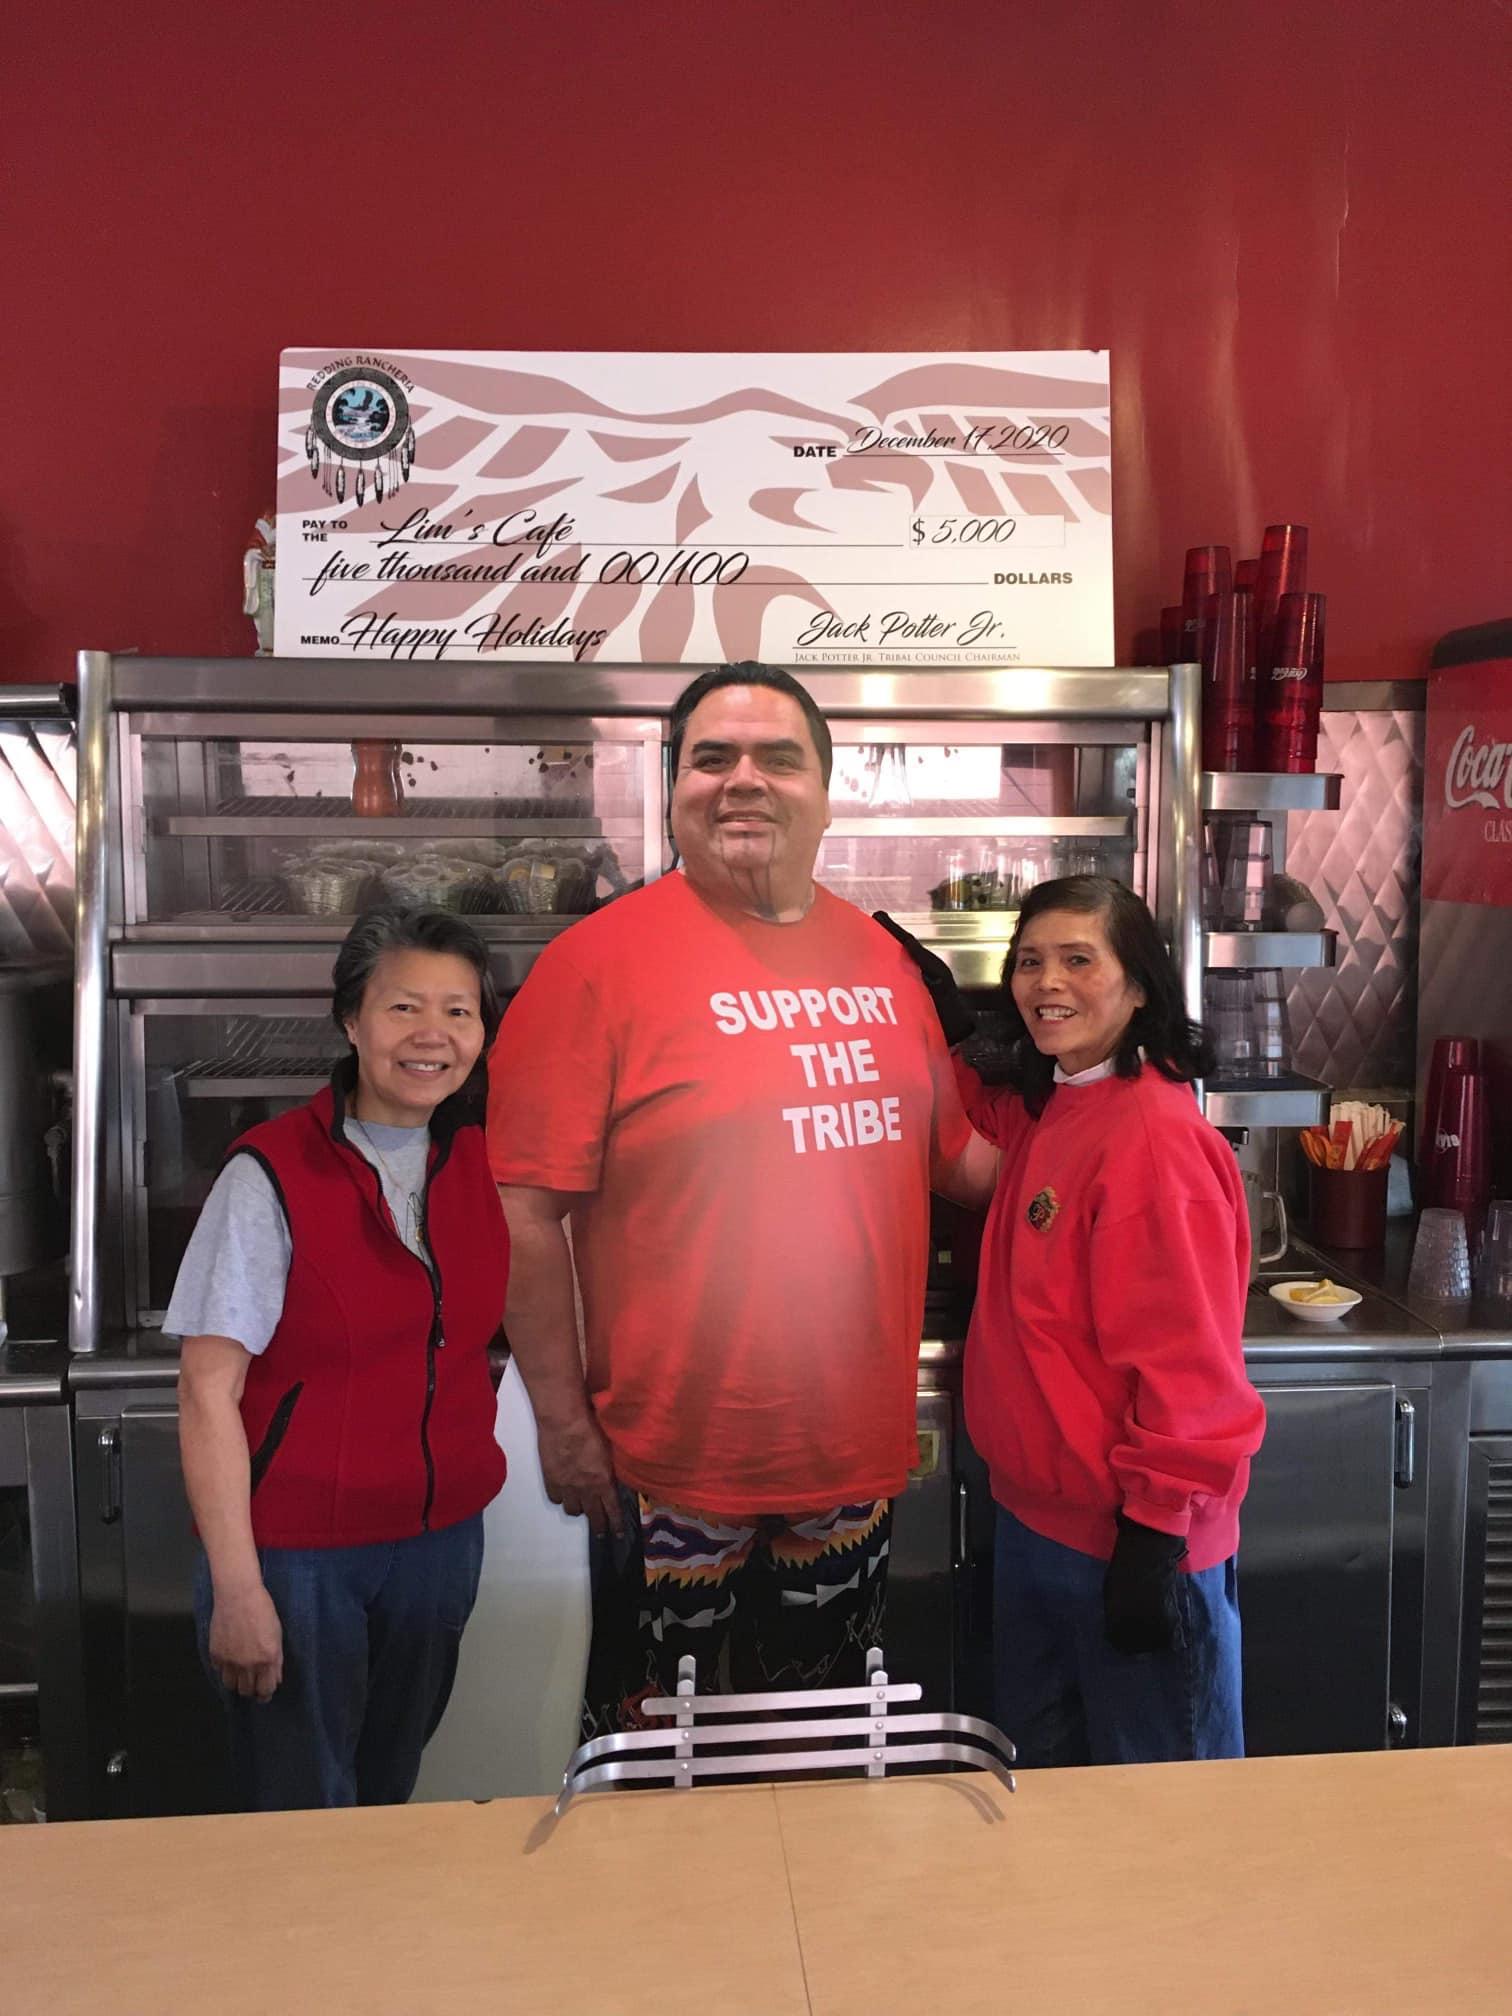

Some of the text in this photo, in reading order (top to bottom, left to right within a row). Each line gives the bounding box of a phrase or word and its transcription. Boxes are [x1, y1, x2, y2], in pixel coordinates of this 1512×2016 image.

[306, 355, 415, 393] REDDING RANCHERIA
[793, 445, 837, 457] DATE
[847, 426, 956, 454] December
[302, 520, 348, 529] PAY TO
[303, 532, 328, 542] THE
[493, 509, 576, 558] Café
[309, 549, 750, 596] five thousand and 00/100
[993, 572, 1073, 585] DOLLARS
[300, 612, 607, 662] MEMO Happy Holidays
[797, 610, 1005, 647] Jack Potter Jr.
[878, 653, 911, 662] TRIBAL
[912, 653, 961, 662] COUNCIL
[965, 653, 1021, 662] CHAIRMAN
[709, 986, 898, 1035] SUPPORT
[789, 1039, 880, 1088] THE
[782, 1096, 902, 1154] TRIBE
